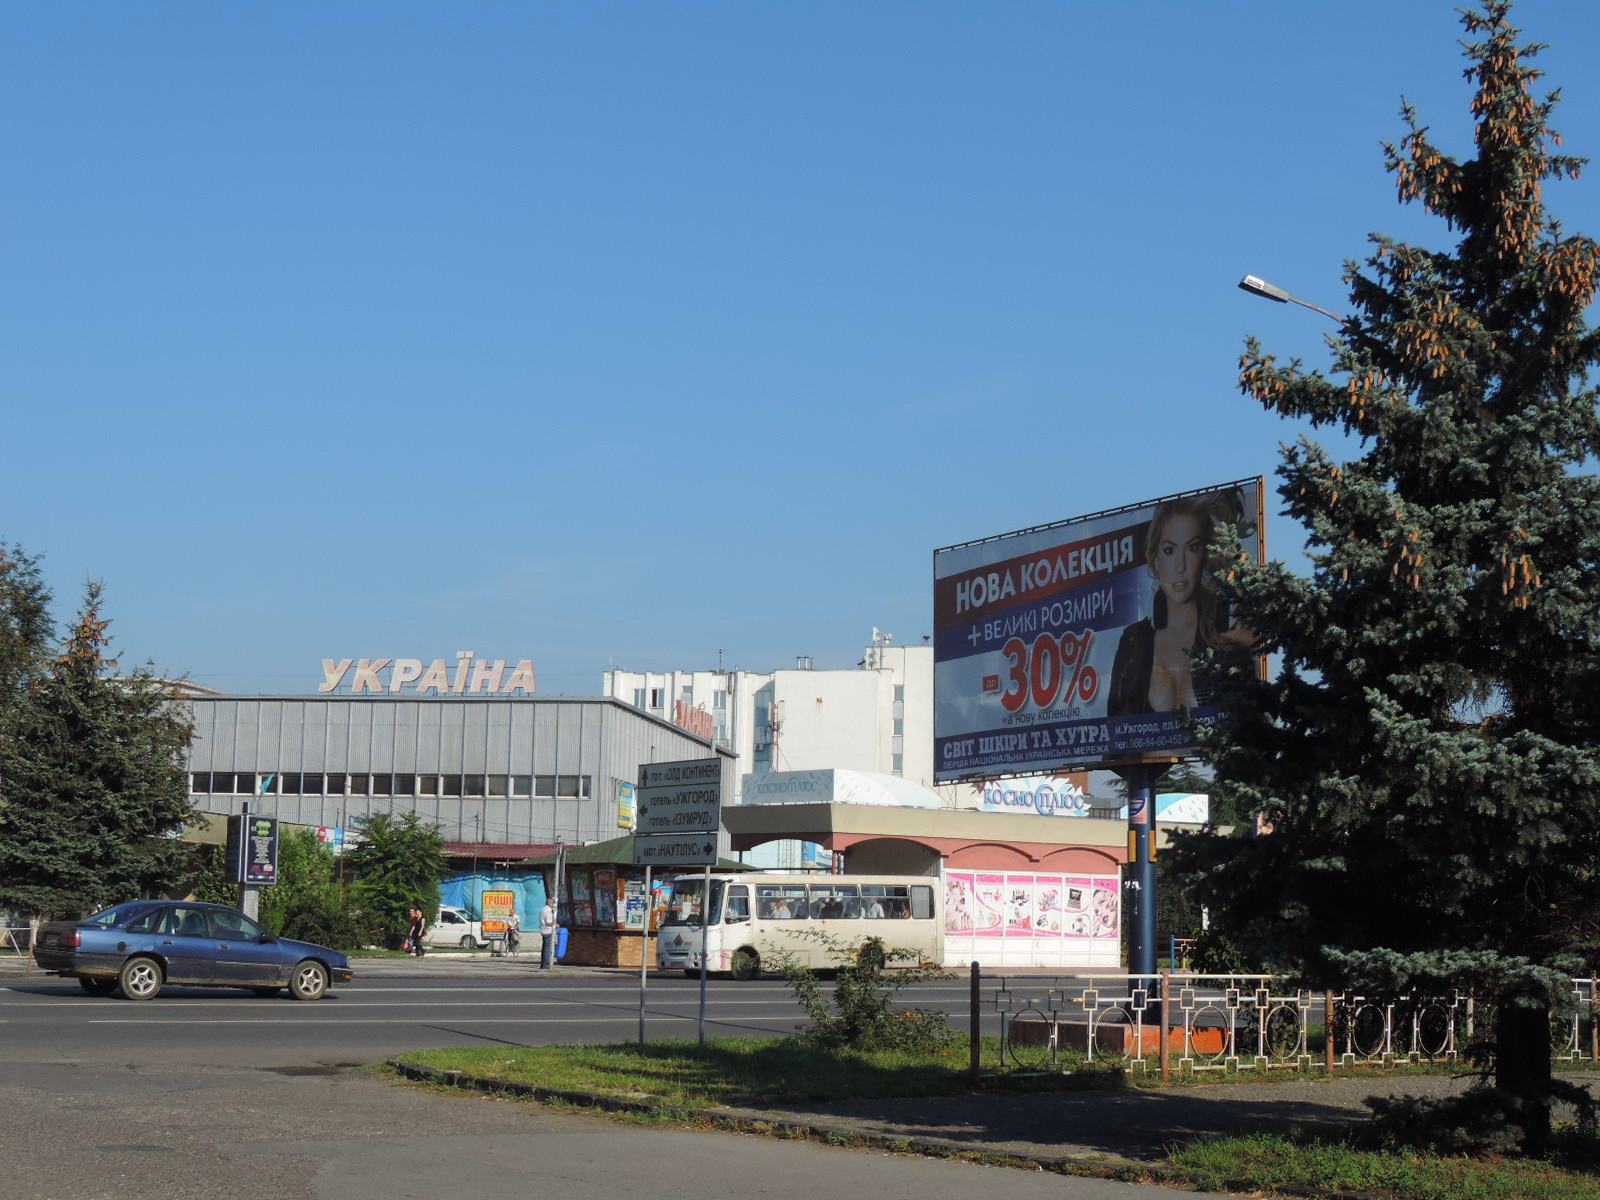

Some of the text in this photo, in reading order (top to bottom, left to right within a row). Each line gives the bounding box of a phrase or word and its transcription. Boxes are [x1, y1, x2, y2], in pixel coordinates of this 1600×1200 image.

[957, 535, 1133, 614] НОВА КОЛЕКЦІЯ
[985, 610, 1036, 641] ВЕЛИКІ
[1042, 587, 1114, 628] РОЗМІРИ
[319, 649, 536, 693] УКРАЇНА
[1015, 712, 1035, 725] нову
[1039, 705, 1080, 721] колекцію
[943, 724, 1110, 759] СВІТ ШКІРИ ТА ХУТРА
[943, 743, 1109, 770] ПЕРША НАЦІОНАЛЬНА УКРАЇНСЬКА МЕРЕЖА
[484, 895, 512, 905] ГРОШІ
